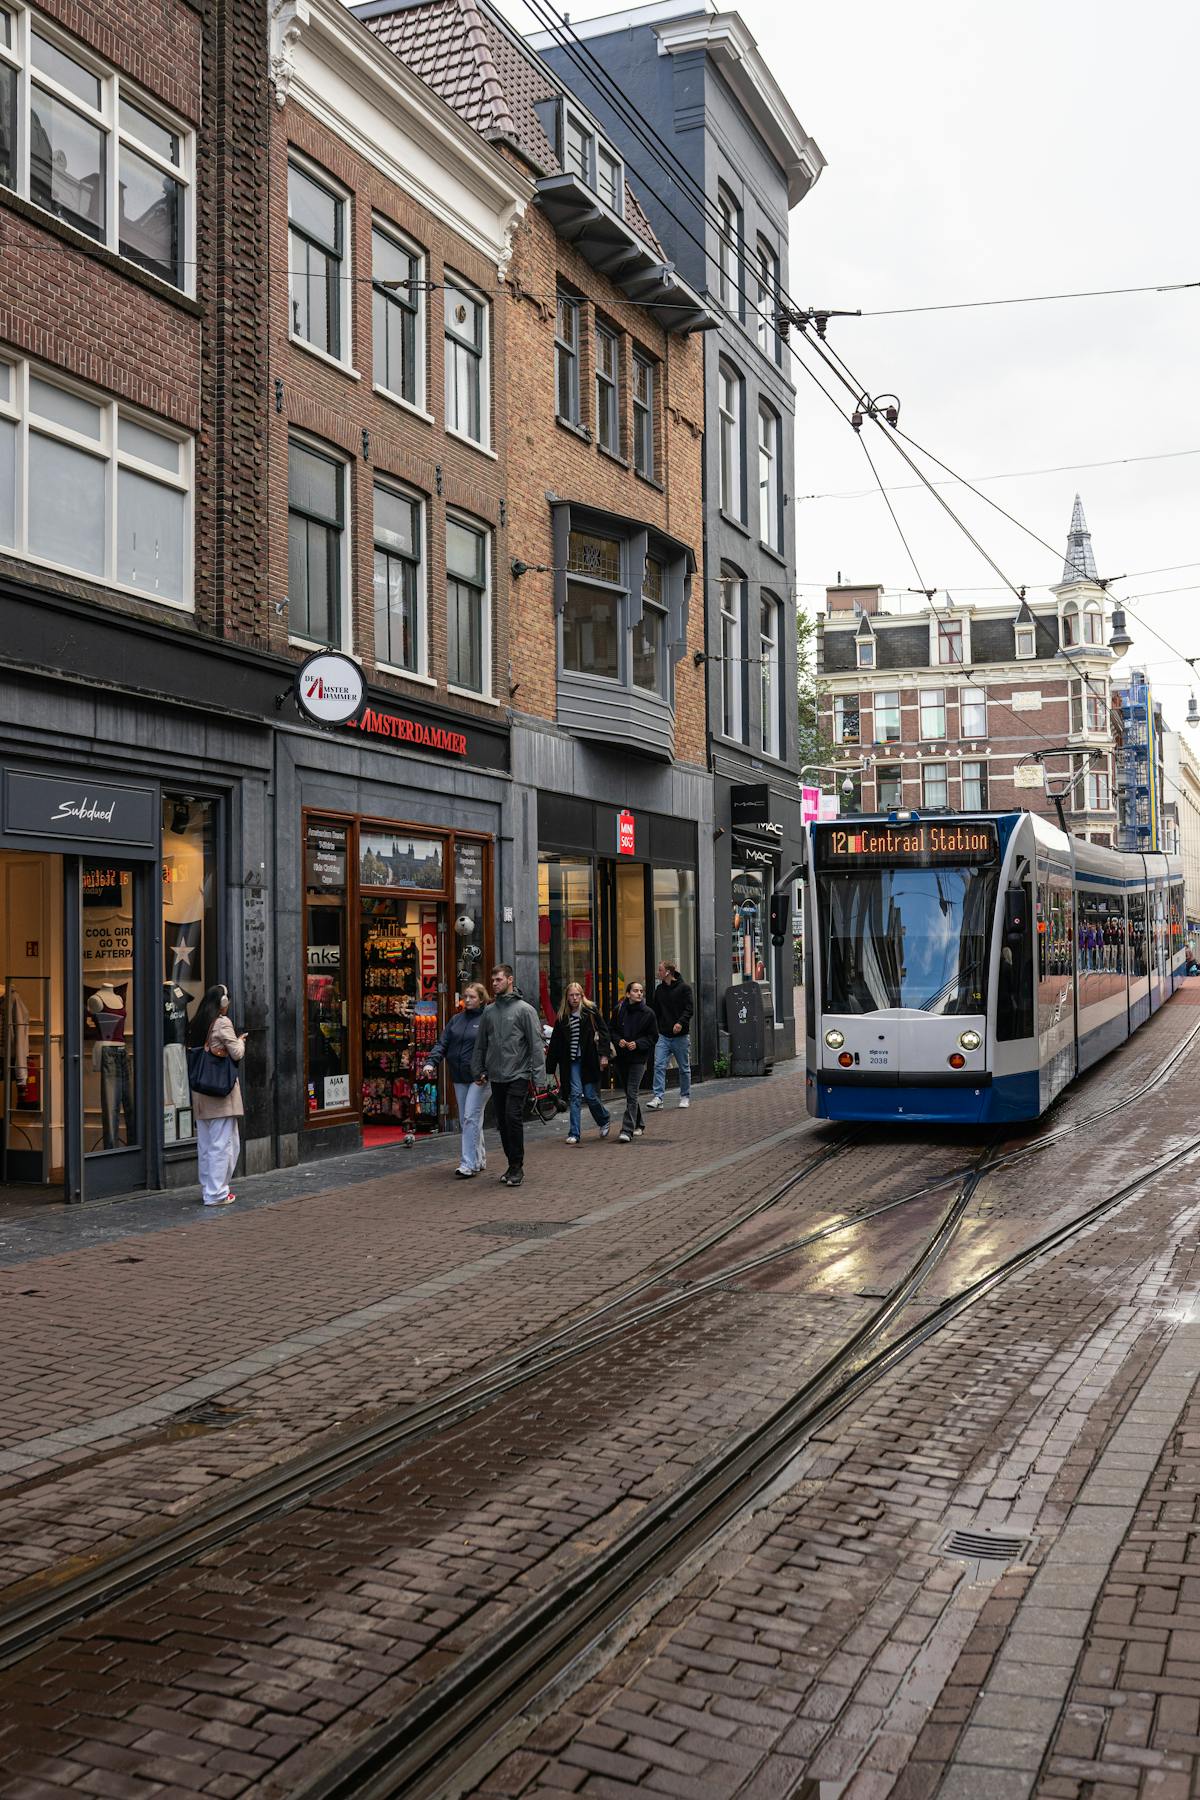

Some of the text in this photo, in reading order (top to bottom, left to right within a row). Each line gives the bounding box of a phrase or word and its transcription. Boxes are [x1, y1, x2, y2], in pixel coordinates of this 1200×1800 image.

[360, 707, 467, 755] AMSTERDAMMER
[51, 797, 115, 823] Subdued
[621, 822, 633, 834] MINI
[758, 822, 783, 835] MAC
[831, 828, 988, 853] 12 Centraal Station
[746, 849, 772, 864] MAC
[86, 928, 111, 937] COOL
[99, 938, 128, 947] GO TO
[330, 1077, 344, 1086] AJAX
